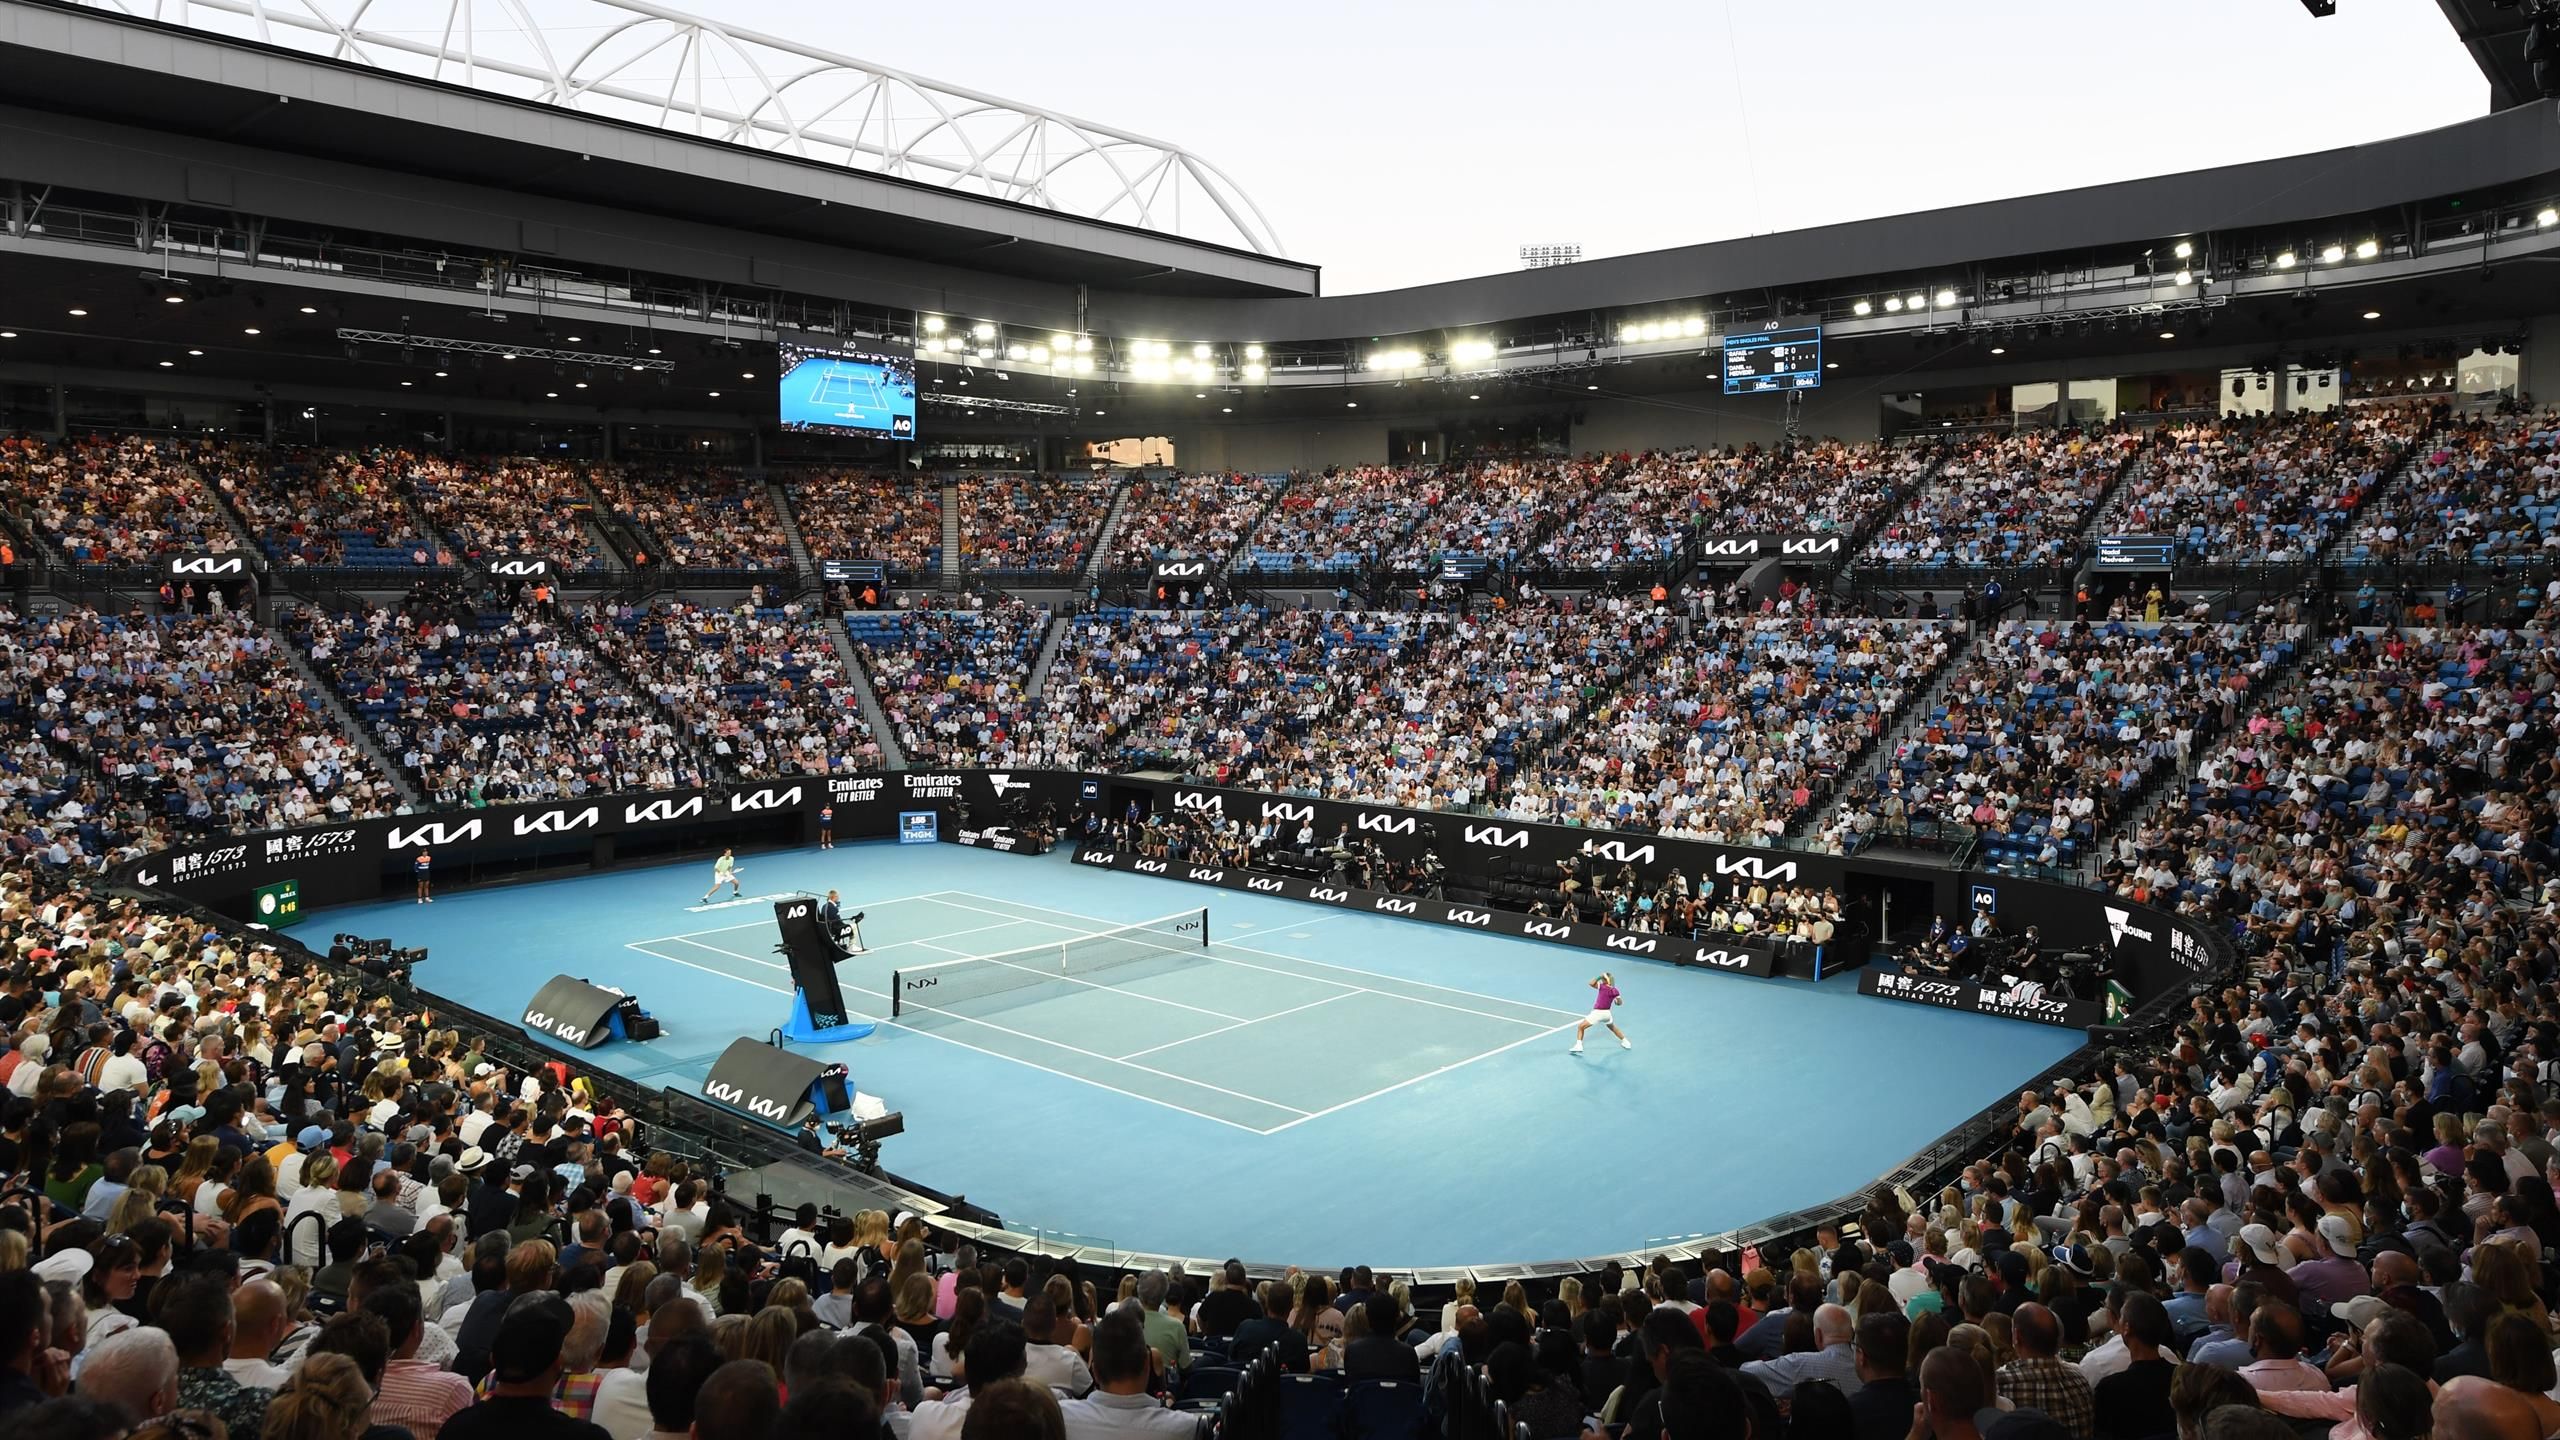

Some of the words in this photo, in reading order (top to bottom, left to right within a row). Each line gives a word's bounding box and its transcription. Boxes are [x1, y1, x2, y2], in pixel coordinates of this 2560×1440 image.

[1764, 321, 1779, 331] AO
[842, 340, 856, 349] AO
[1784, 347, 1789, 355] 2
[1791, 362, 1796, 370] 0
[893, 419, 911, 431] AO
[1706, 540, 1758, 555] KIA
[1783, 538, 1840, 554] KIA
[172, 558, 242, 574] KIA
[491, 561, 545, 575] KIA
[1158, 562, 1204, 576] KIA
[828, 778, 884, 792] Emirates
[904, 774, 962, 787] Emirates
[836, 791, 849, 803] FLY
[849, 789, 875, 802] BETTER
[912, 787, 926, 798] FLY
[927, 786, 954, 797] BETTER
[1084, 785, 1096, 794] AO
[732, 787, 802, 811] KIA
[1175, 791, 1222, 811] KIA
[626, 797, 702, 823] KIA
[1262, 801, 1314, 821] KIA
[514, 807, 598, 835] KIA
[1358, 812, 1415, 834] KIA
[388, 819, 481, 849] KIA
[1464, 824, 1529, 848] KIA
[266, 850, 318, 863] GUOJIAO
[327, 844, 356, 854] 1573
[1083, 851, 1113, 864] KIA
[1584, 838, 1654, 864] KIA
[173, 867, 215, 883] GUOJIAO
[222, 861, 247, 872] 1573
[1135, 858, 1167, 873] KIA
[1716, 855, 1797, 884] KIA
[1189, 867, 1223, 882] KIA
[1248, 877, 1283, 892] KIA
[1310, 887, 1347, 903] KIA
[1974, 893, 1993, 906] AO
[787, 905, 807, 919] AO
[1376, 897, 1416, 914] KIA
[1447, 908, 1491, 926] KIA
[840, 925, 852, 936] AO
[1524, 920, 1571, 940] KIA
[1606, 933, 1656, 953] KIA
[1696, 948, 1749, 968] KIA
[1876, 987, 1924, 1000] GUOJIAO
[1932, 997, 1958, 1006] 1573
[1977, 1003, 2029, 1017] GUOJIAO
[2038, 1013, 2064, 1023] 1573
[525, 1009, 553, 1030] KIA
[556, 1023, 586, 1043] KIA
[706, 1080, 744, 1105] KIA
[748, 1096, 788, 1121] KIA
